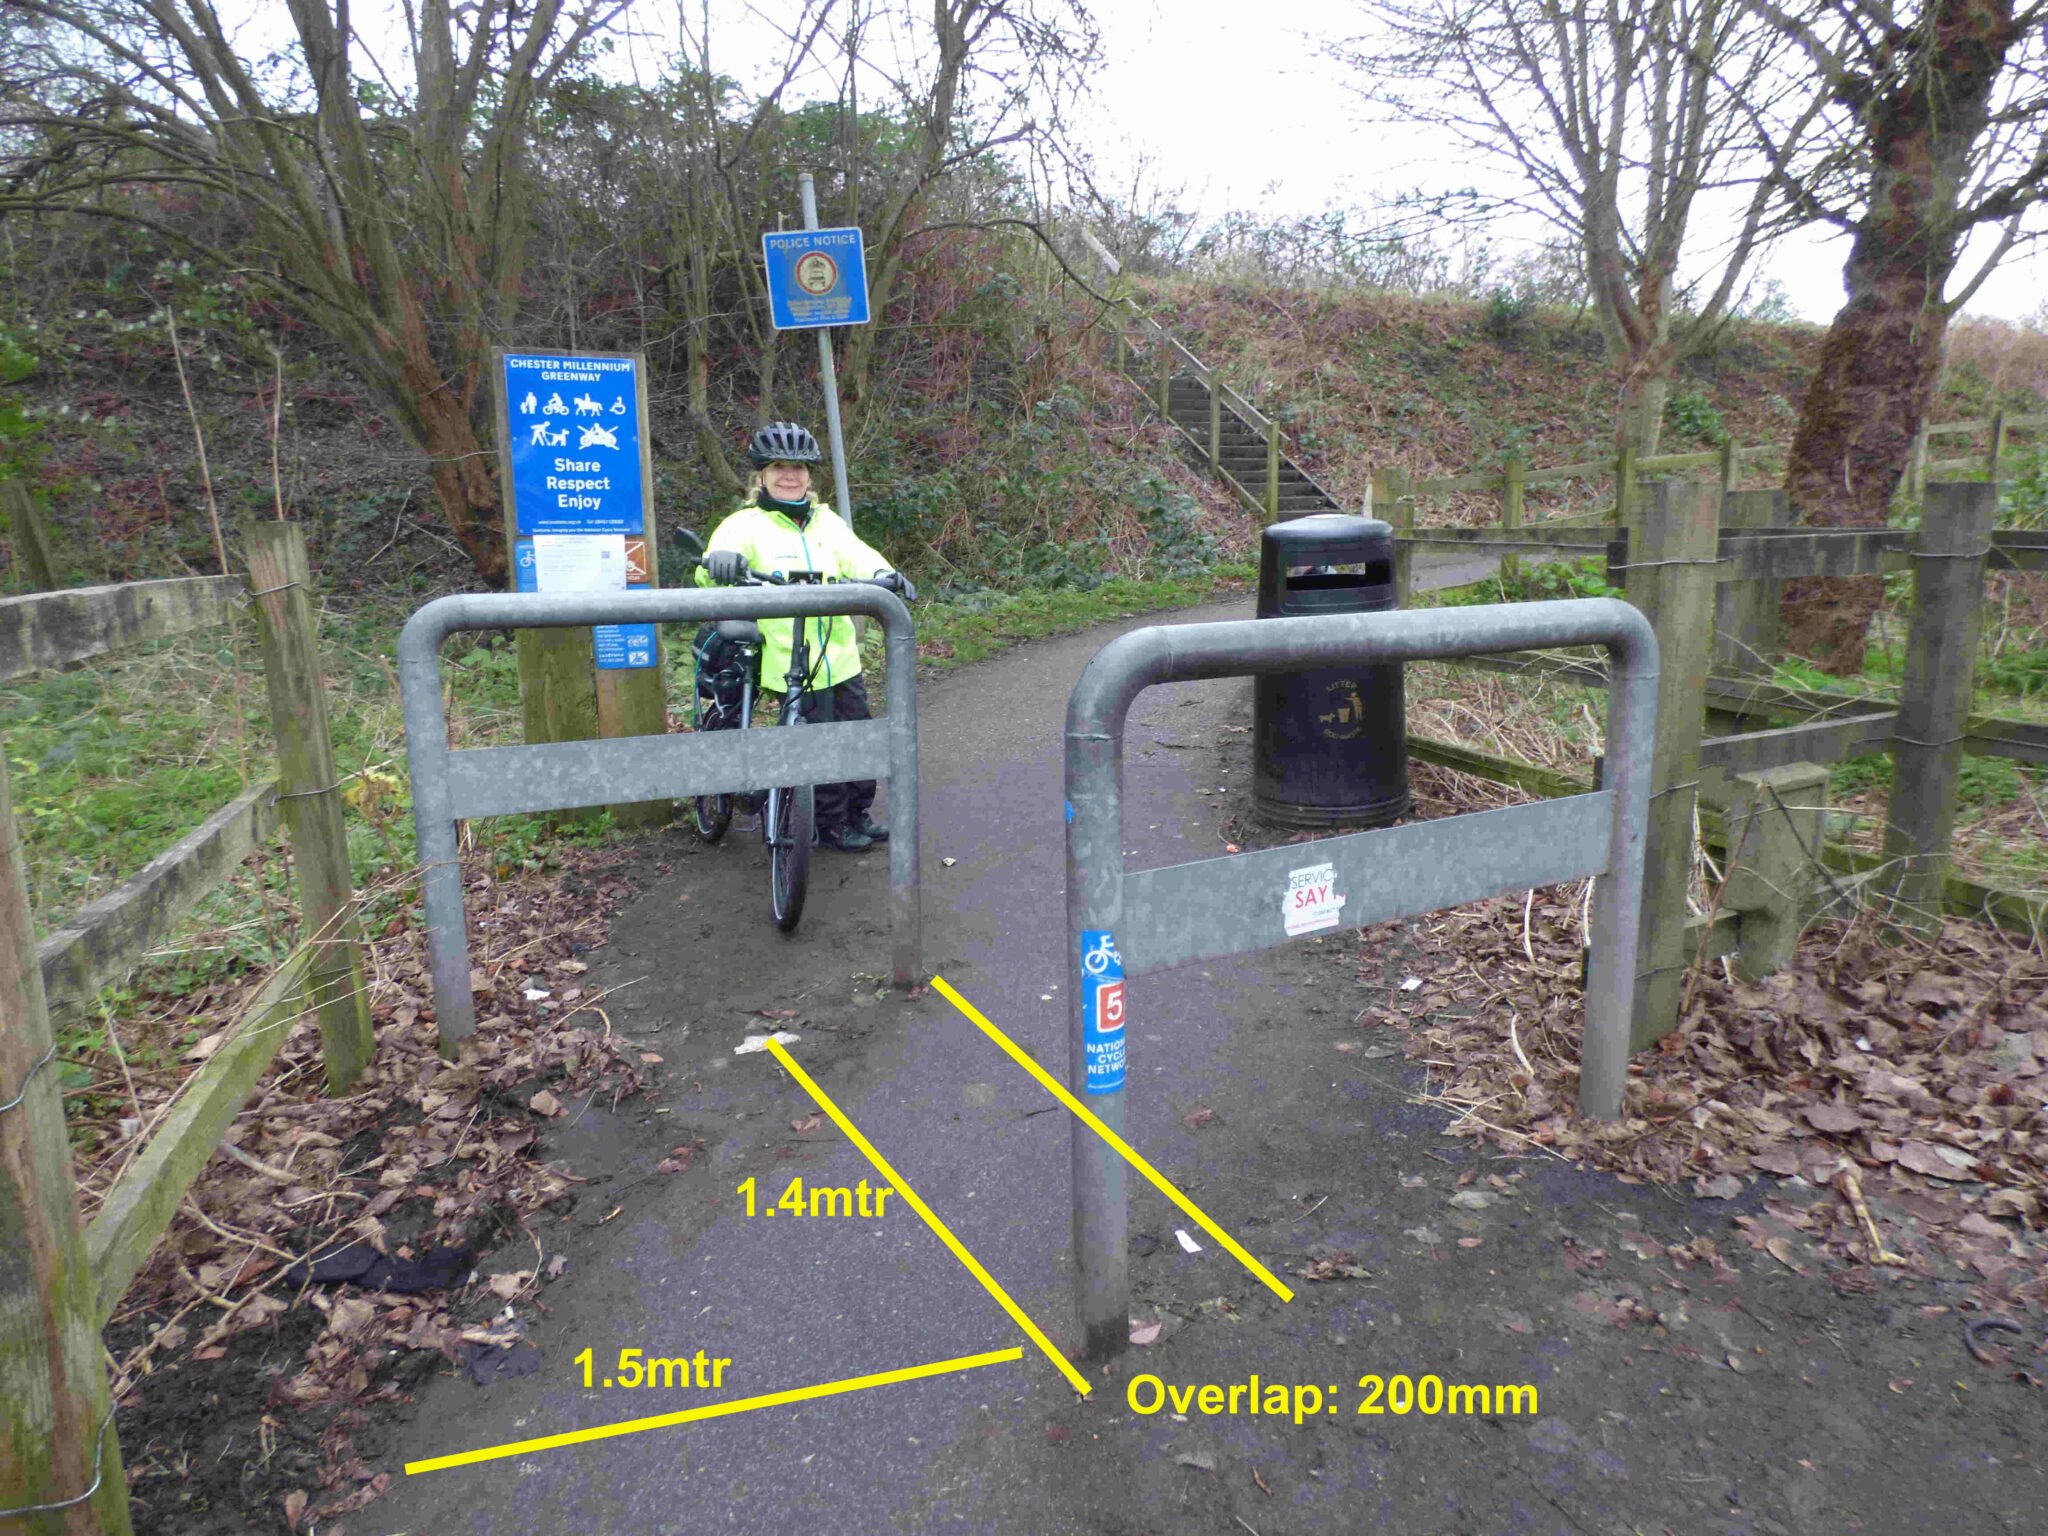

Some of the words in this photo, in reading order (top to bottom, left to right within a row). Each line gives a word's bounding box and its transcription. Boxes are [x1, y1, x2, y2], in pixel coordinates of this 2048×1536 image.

[769, 237, 811, 249] POLICE
[814, 234, 857, 246] NOTICE
[510, 359, 560, 370] CHESTER
[563, 361, 631, 372] MILLENNIUM
[541, 371, 602, 382] GREENWAY
[554, 458, 601, 472] Share
[546, 476, 611, 492] Respect
[557, 494, 602, 510] Enjoy
[1290, 868, 1337, 890] SERVIC
[1295, 884, 1328, 909] SAY
[1106, 990, 1123, 1021] 5
